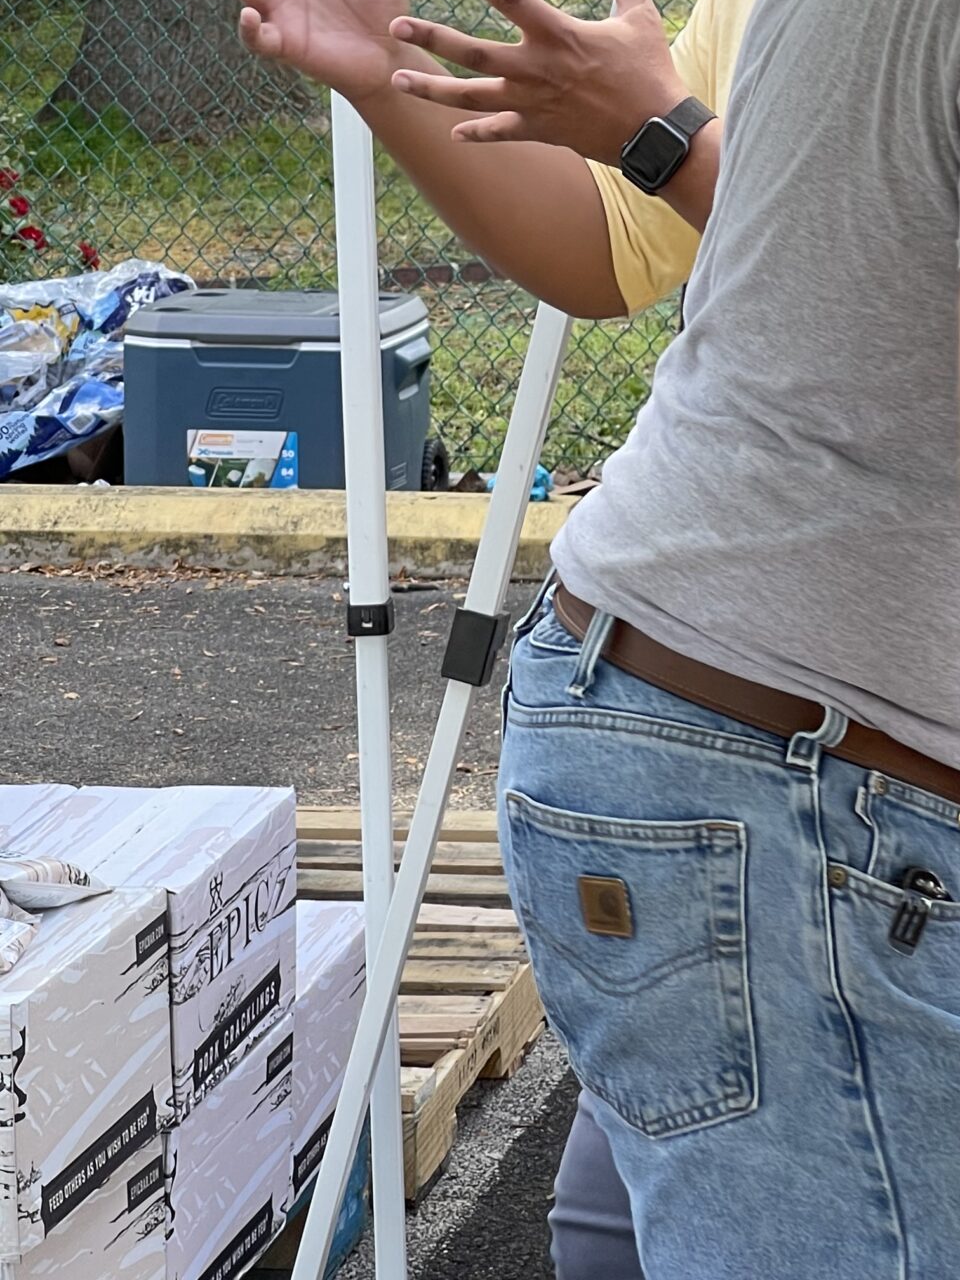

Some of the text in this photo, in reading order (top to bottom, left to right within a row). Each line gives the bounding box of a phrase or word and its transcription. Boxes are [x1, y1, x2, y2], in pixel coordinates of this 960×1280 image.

[207, 876, 269, 986] EPIC
[223, 981, 275, 1050] CRACKLINGS
[48, 1190, 64, 1213] FEED
[64, 1169, 86, 1199] OTHERS
[87, 1161, 95, 1179] AS
[94, 1150, 107, 1171] YOU
[106, 1136, 121, 1159] WISH
[122, 1129, 130, 1145] TO
[129, 1121, 137, 1139] BE
[245, 1235, 251, 1251] TO
[251, 1228, 257, 1244] BE
